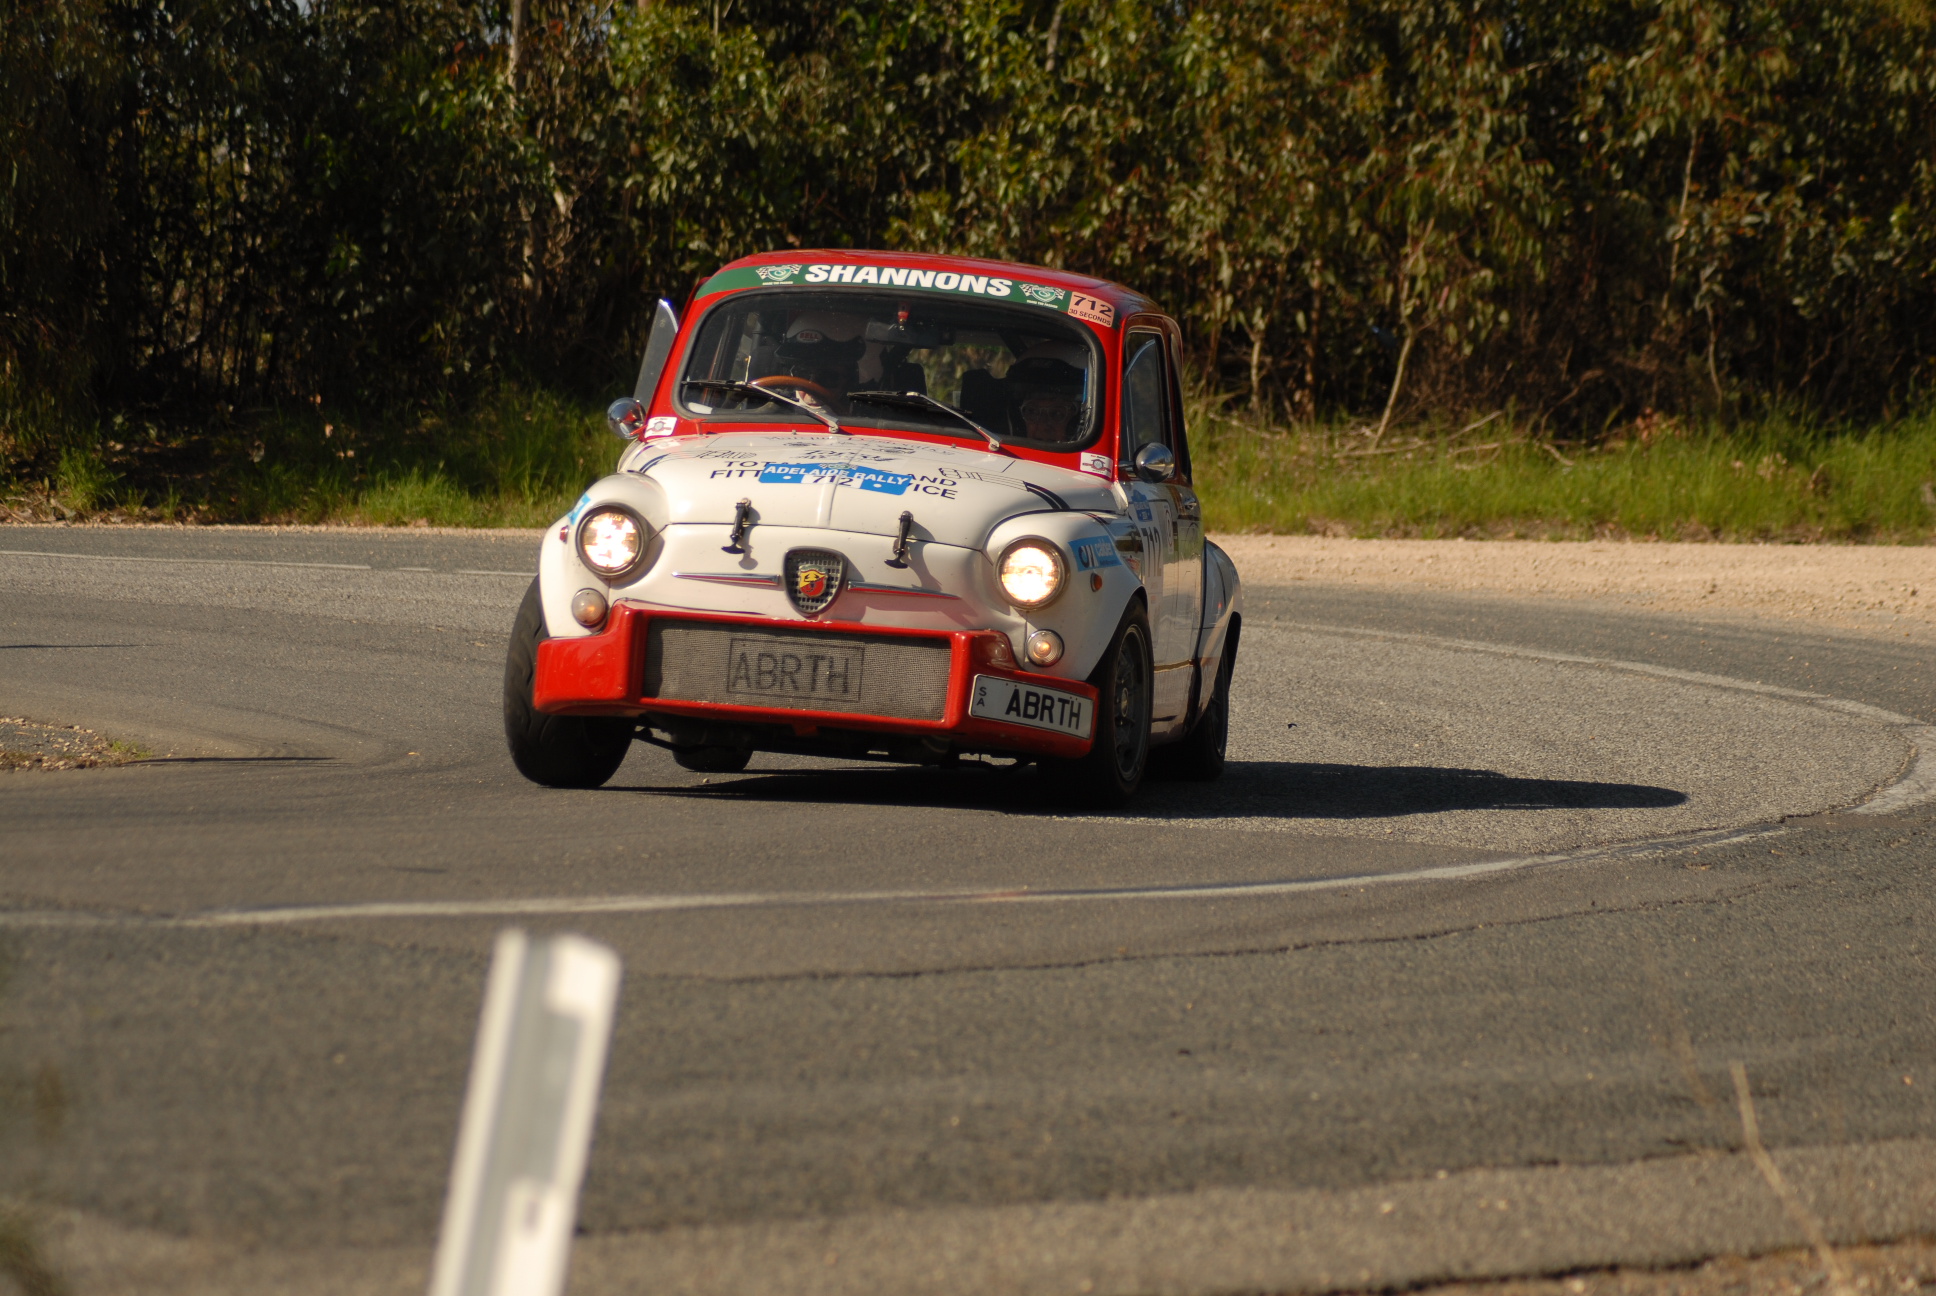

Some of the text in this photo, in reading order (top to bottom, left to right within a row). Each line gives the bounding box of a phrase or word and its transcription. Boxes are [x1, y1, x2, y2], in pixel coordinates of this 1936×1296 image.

[804, 264, 1013, 297] SHANNONS
[1073, 294, 1112, 318] 712
[1079, 310, 1111, 326] SECONDS
[763, 465, 909, 486] ADELAIDE RALLY
[813, 474, 854, 487] 712
[731, 651, 850, 694] ABRTH
[1005, 688, 1082, 731] ABRTH
